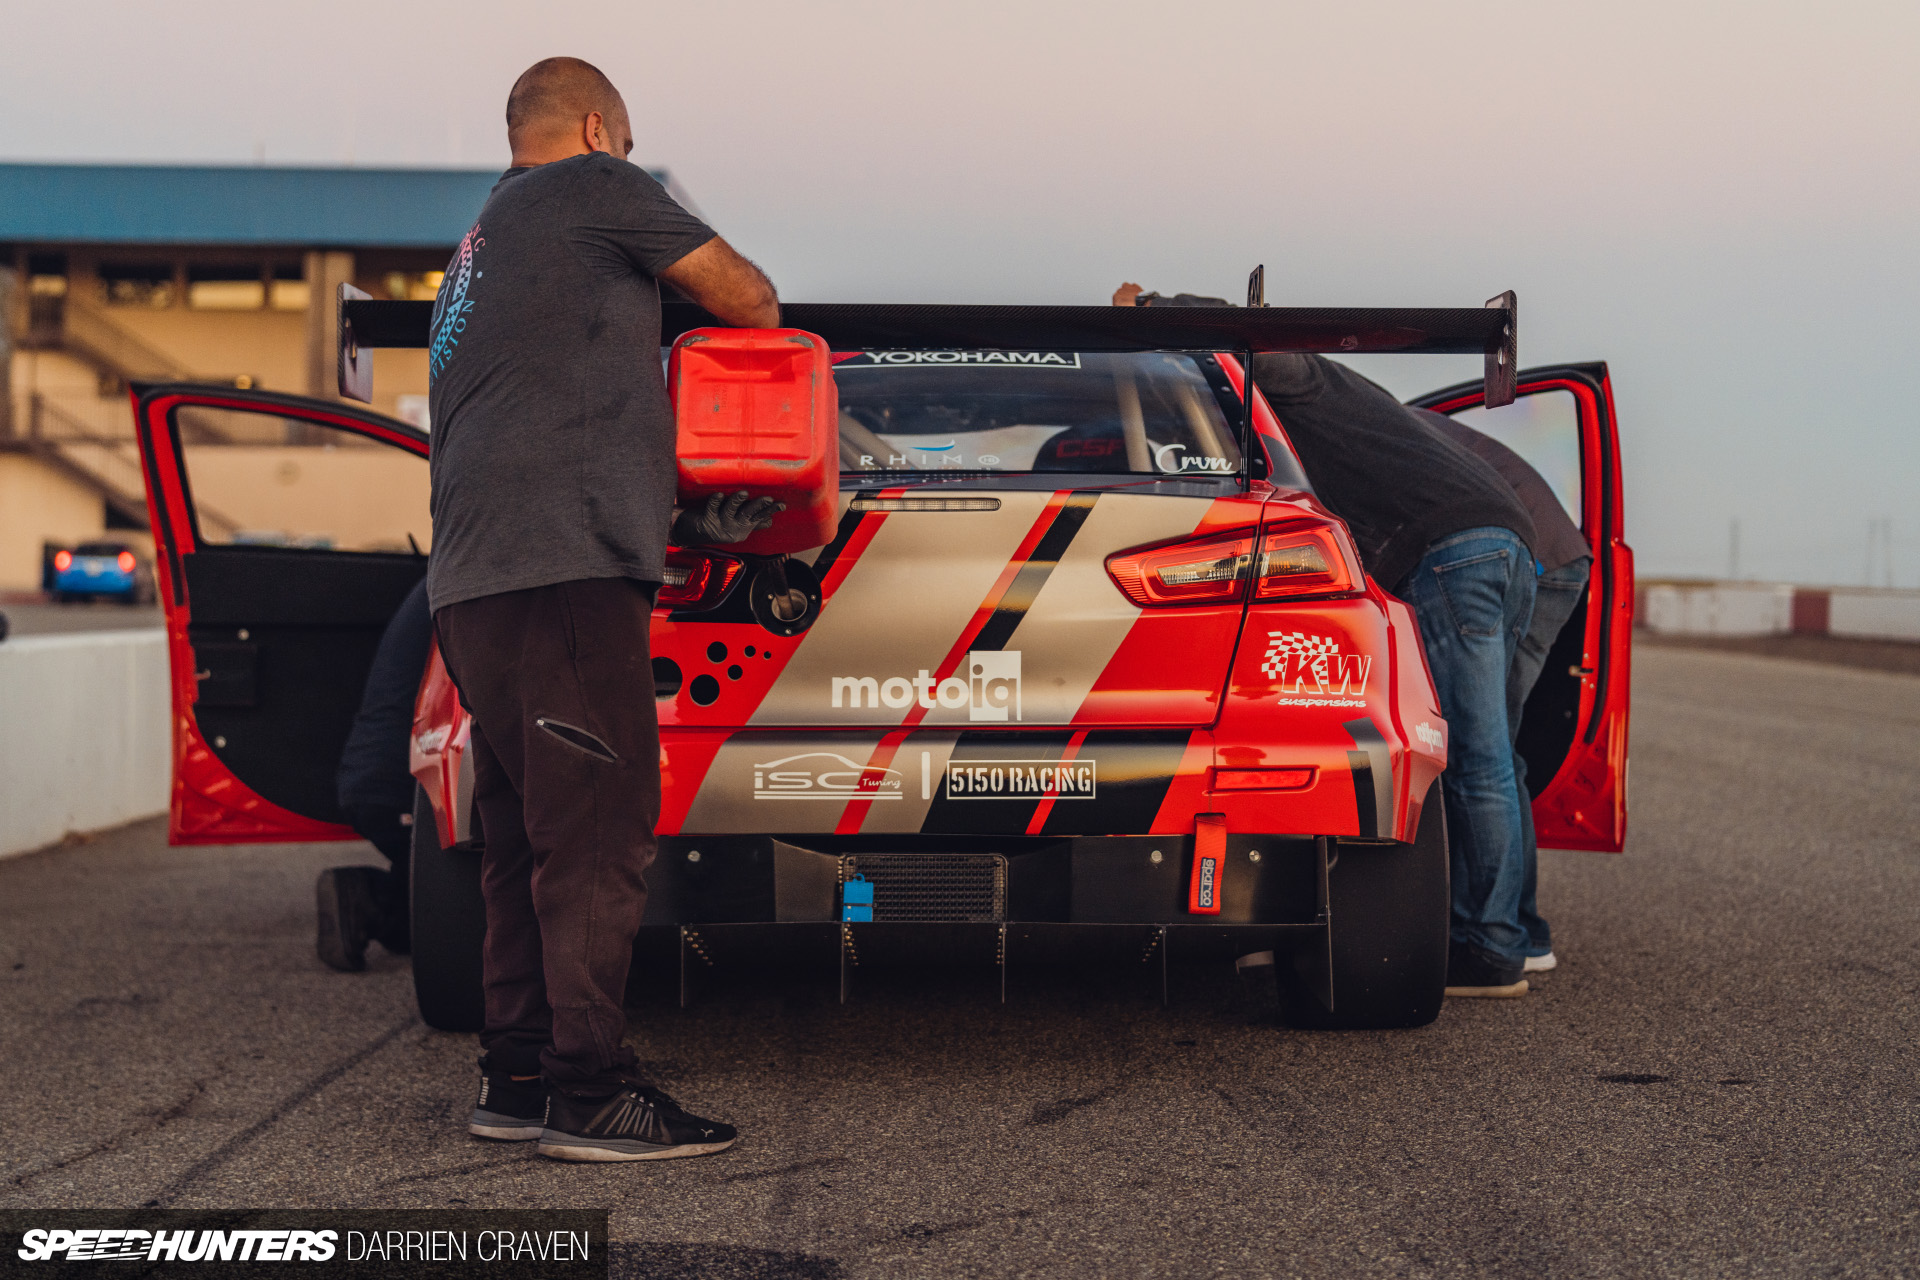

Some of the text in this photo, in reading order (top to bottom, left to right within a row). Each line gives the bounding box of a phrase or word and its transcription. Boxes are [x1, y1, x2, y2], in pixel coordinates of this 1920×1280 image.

[864, 351, 1068, 364] YOKOHAMA
[1281, 653, 1372, 696] KW
[1277, 697, 1367, 708] suspensions
[862, 778, 901, 789] Tuning
[951, 767, 1091, 792] 5150 RACING
